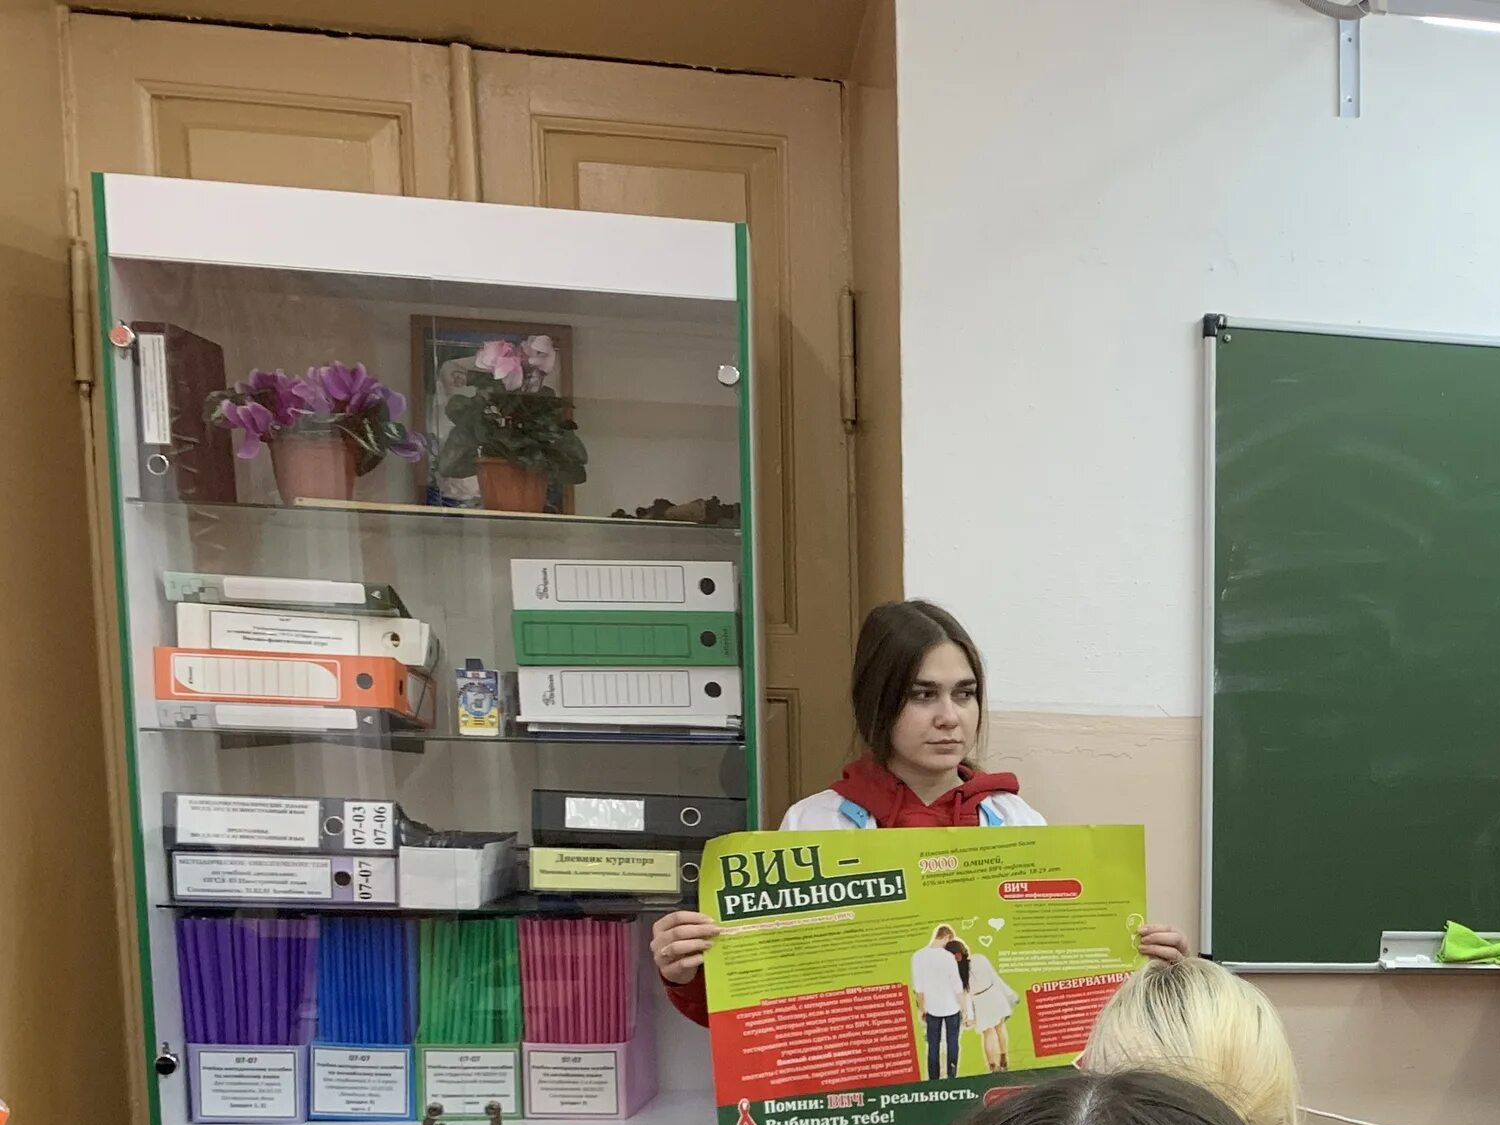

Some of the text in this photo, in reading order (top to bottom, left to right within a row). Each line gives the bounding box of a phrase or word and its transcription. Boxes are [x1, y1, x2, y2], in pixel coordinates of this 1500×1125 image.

[352, 805, 367, 846] 07-03
[373, 805, 388, 846] 07-06
[605, 854, 655, 866] куратора
[720, 845, 825, 890] ВИЧ
[919, 856, 959, 873] 9000
[358, 860, 373, 901] 07-07
[1004, 882, 1029, 893] ВИЧ
[724, 875, 904, 916] РЕАЛЬНОСТЬ!
[1032, 984, 1042, 993] О
[763, 1099, 824, 1114] Помни:
[852, 1110, 895, 1125] тебе!
